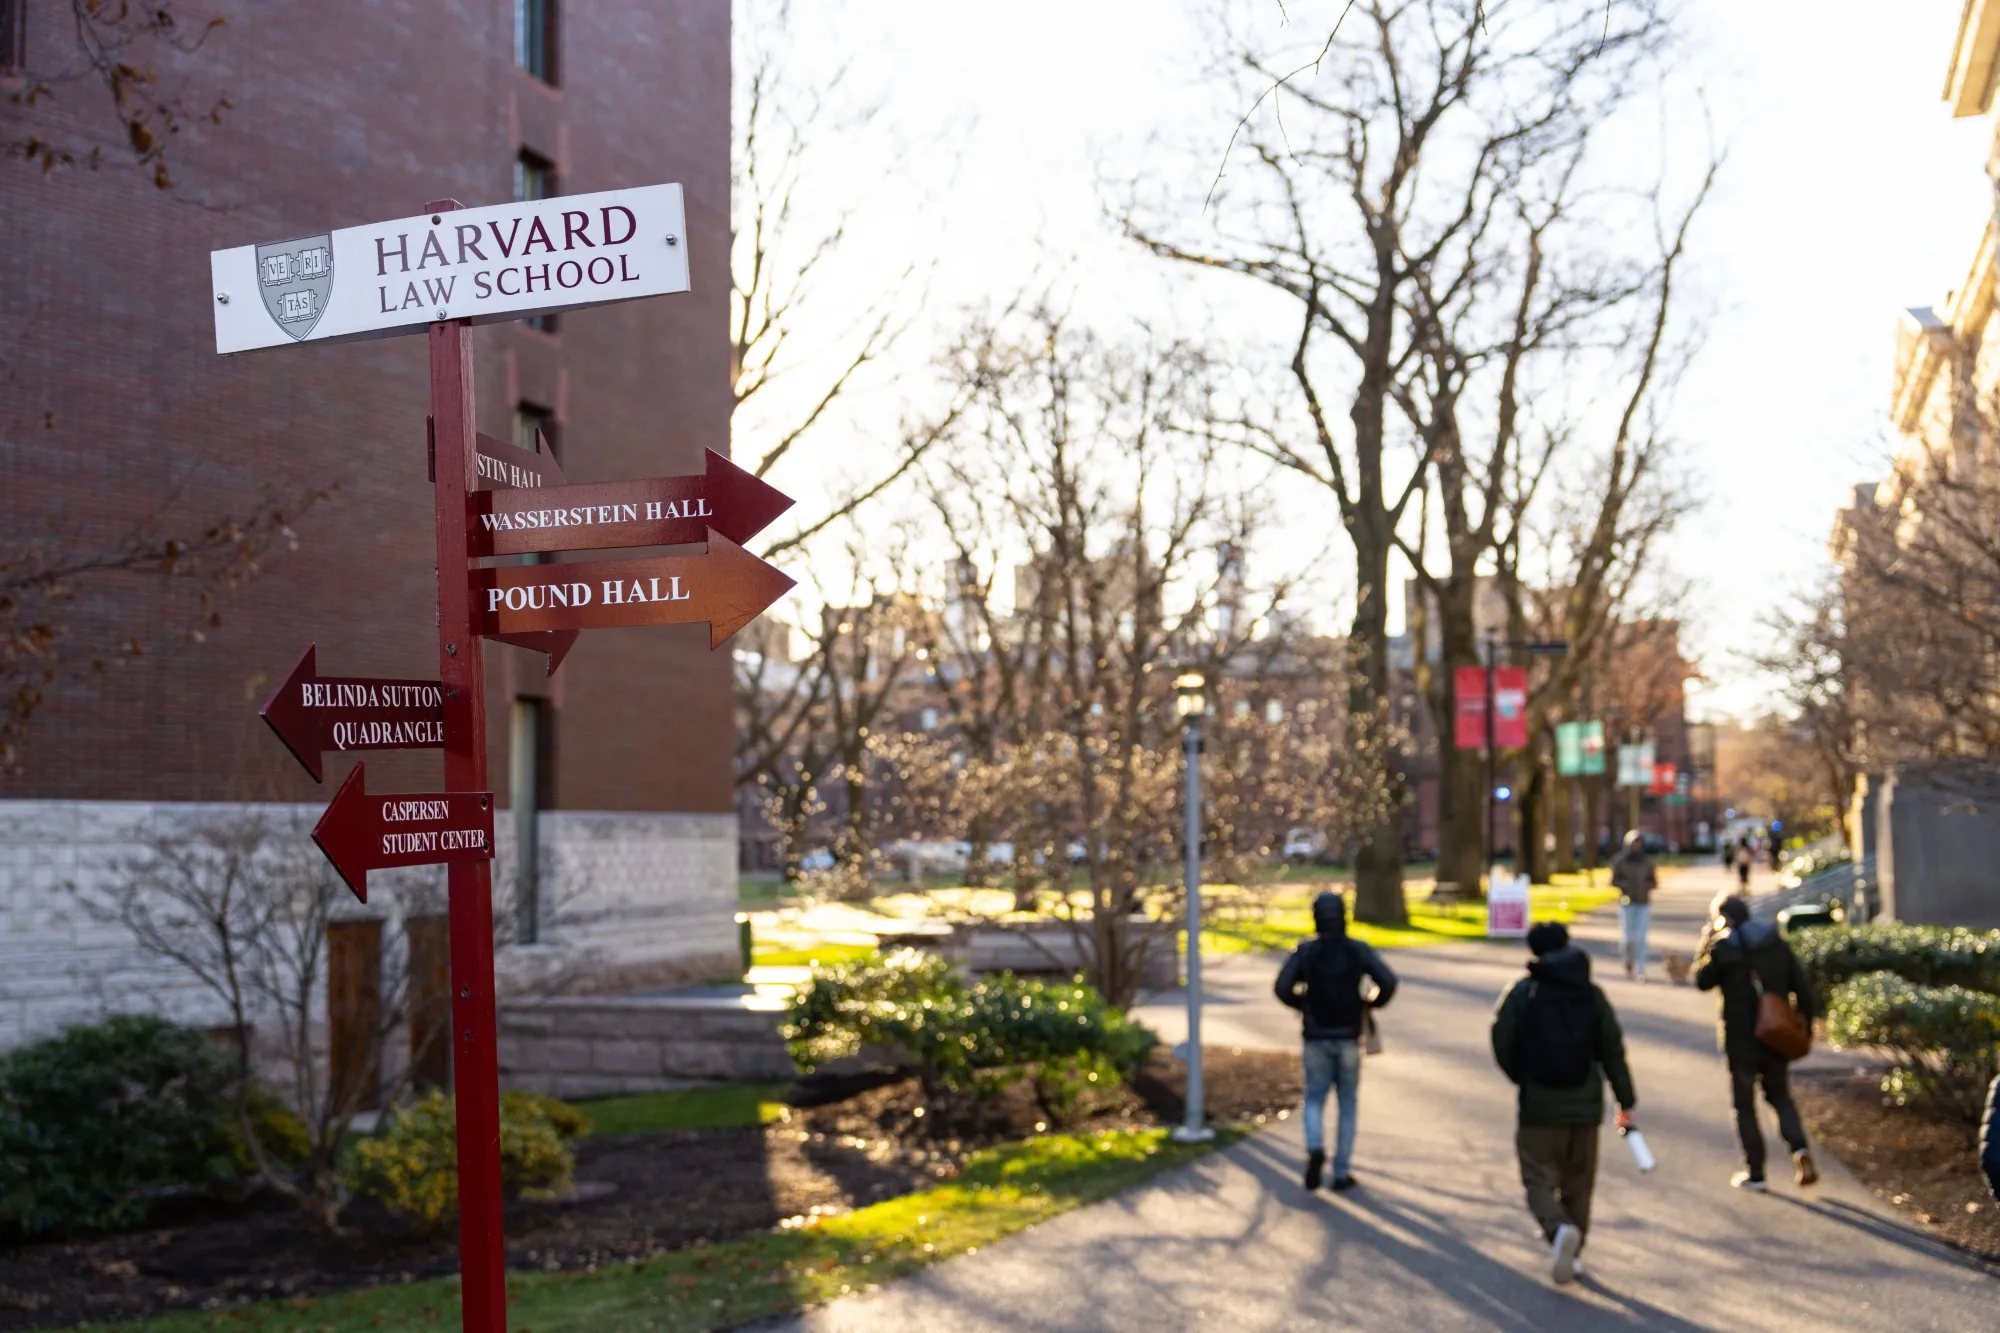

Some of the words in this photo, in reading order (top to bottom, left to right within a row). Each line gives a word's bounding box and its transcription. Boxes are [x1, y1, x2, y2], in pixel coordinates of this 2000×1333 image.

[374, 205, 637, 277] HARVARD
[269, 262, 285, 275] VE
[305, 255, 318, 269] RI
[378, 275, 457, 313] LAW
[474, 254, 640, 299] SCHOOL
[288, 297, 308, 311] TAS
[475, 452, 508, 483] STIN
[480, 503, 637, 532] WASSERSTEIN
[645, 498, 713, 520] HALL
[487, 583, 592, 612] POUND
[601, 576, 690, 605] HALL
[301, 683, 379, 707] BELINDA
[382, 685, 442, 707] SUTTON
[333, 721, 444, 750] QUADRANGLE
[382, 800, 449, 822] CASPERSEN
[383, 832, 438, 855] STUDENT
[440, 829, 485, 850] CENTER
